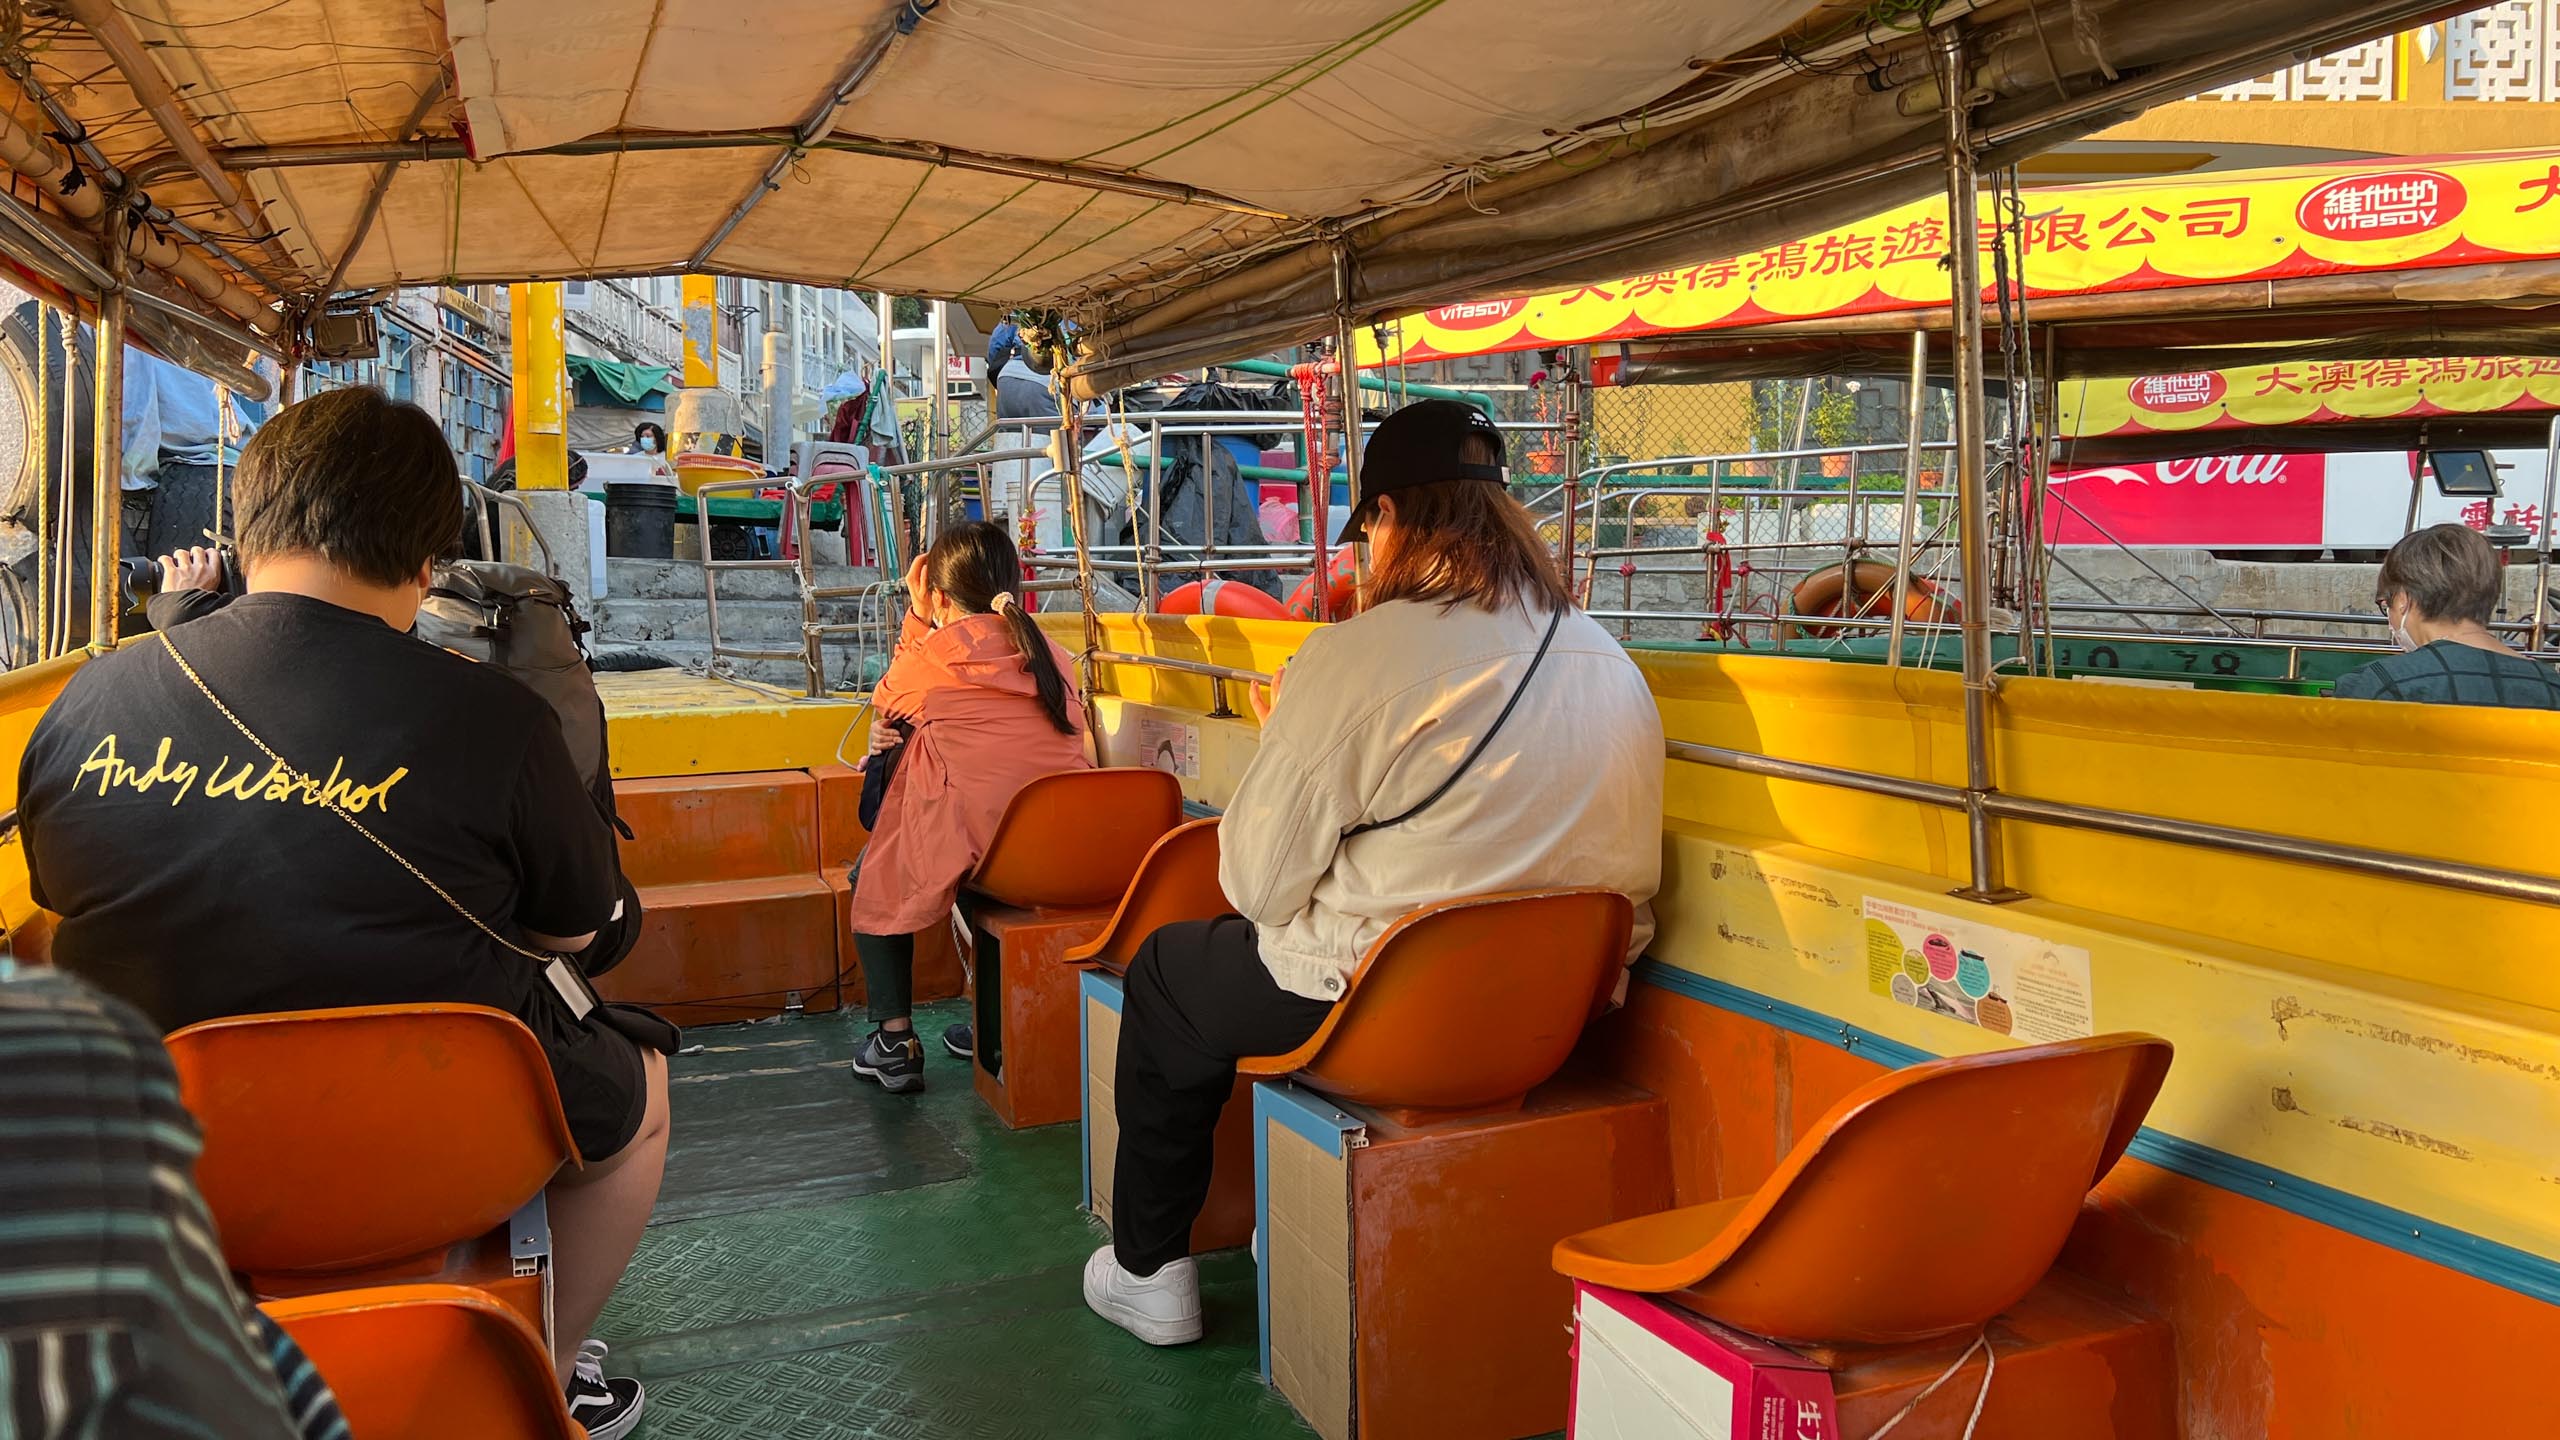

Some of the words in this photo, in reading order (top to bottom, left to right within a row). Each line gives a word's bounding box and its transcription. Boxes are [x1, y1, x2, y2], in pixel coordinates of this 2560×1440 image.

[2323, 179, 2438, 216] 維他奶
[2323, 208, 2438, 232] vitasoy
[1440, 299, 1513, 321] vitasoy
[2144, 373, 2211, 395] 維他奶
[2144, 391, 2210, 405] vitasoy
[72, 734, 198, 807] Andy
[204, 755, 408, 813] Warhol
